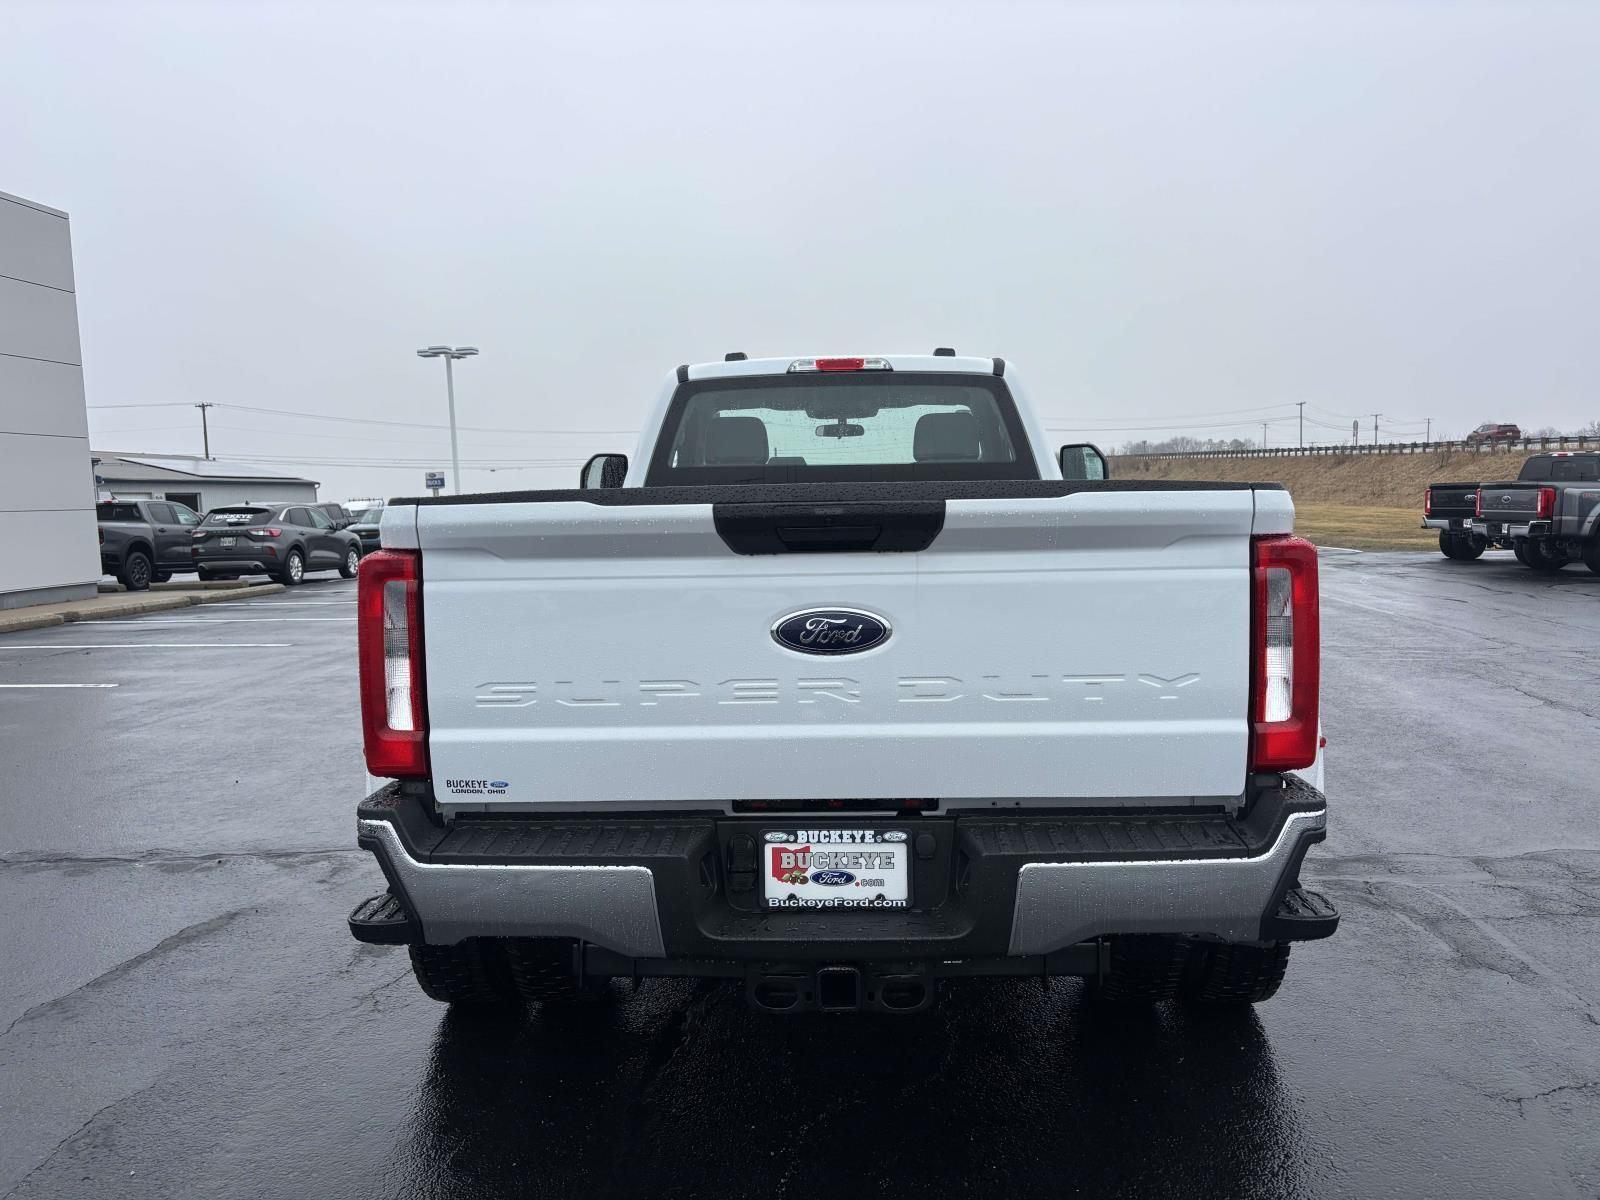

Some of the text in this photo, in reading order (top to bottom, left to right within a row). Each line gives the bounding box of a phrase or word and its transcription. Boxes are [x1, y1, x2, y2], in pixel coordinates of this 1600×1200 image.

[800, 617, 863, 644] Ford
[474, 673, 1200, 708] SUPER DUTY
[446, 780, 488, 788] BUCKEYE
[796, 831, 875, 843] BUCKEYE
[780, 852, 895, 869] BUCKEYE
[818, 872, 847, 884] Ford
[768, 898, 907, 909] BuckeyeFord.com
